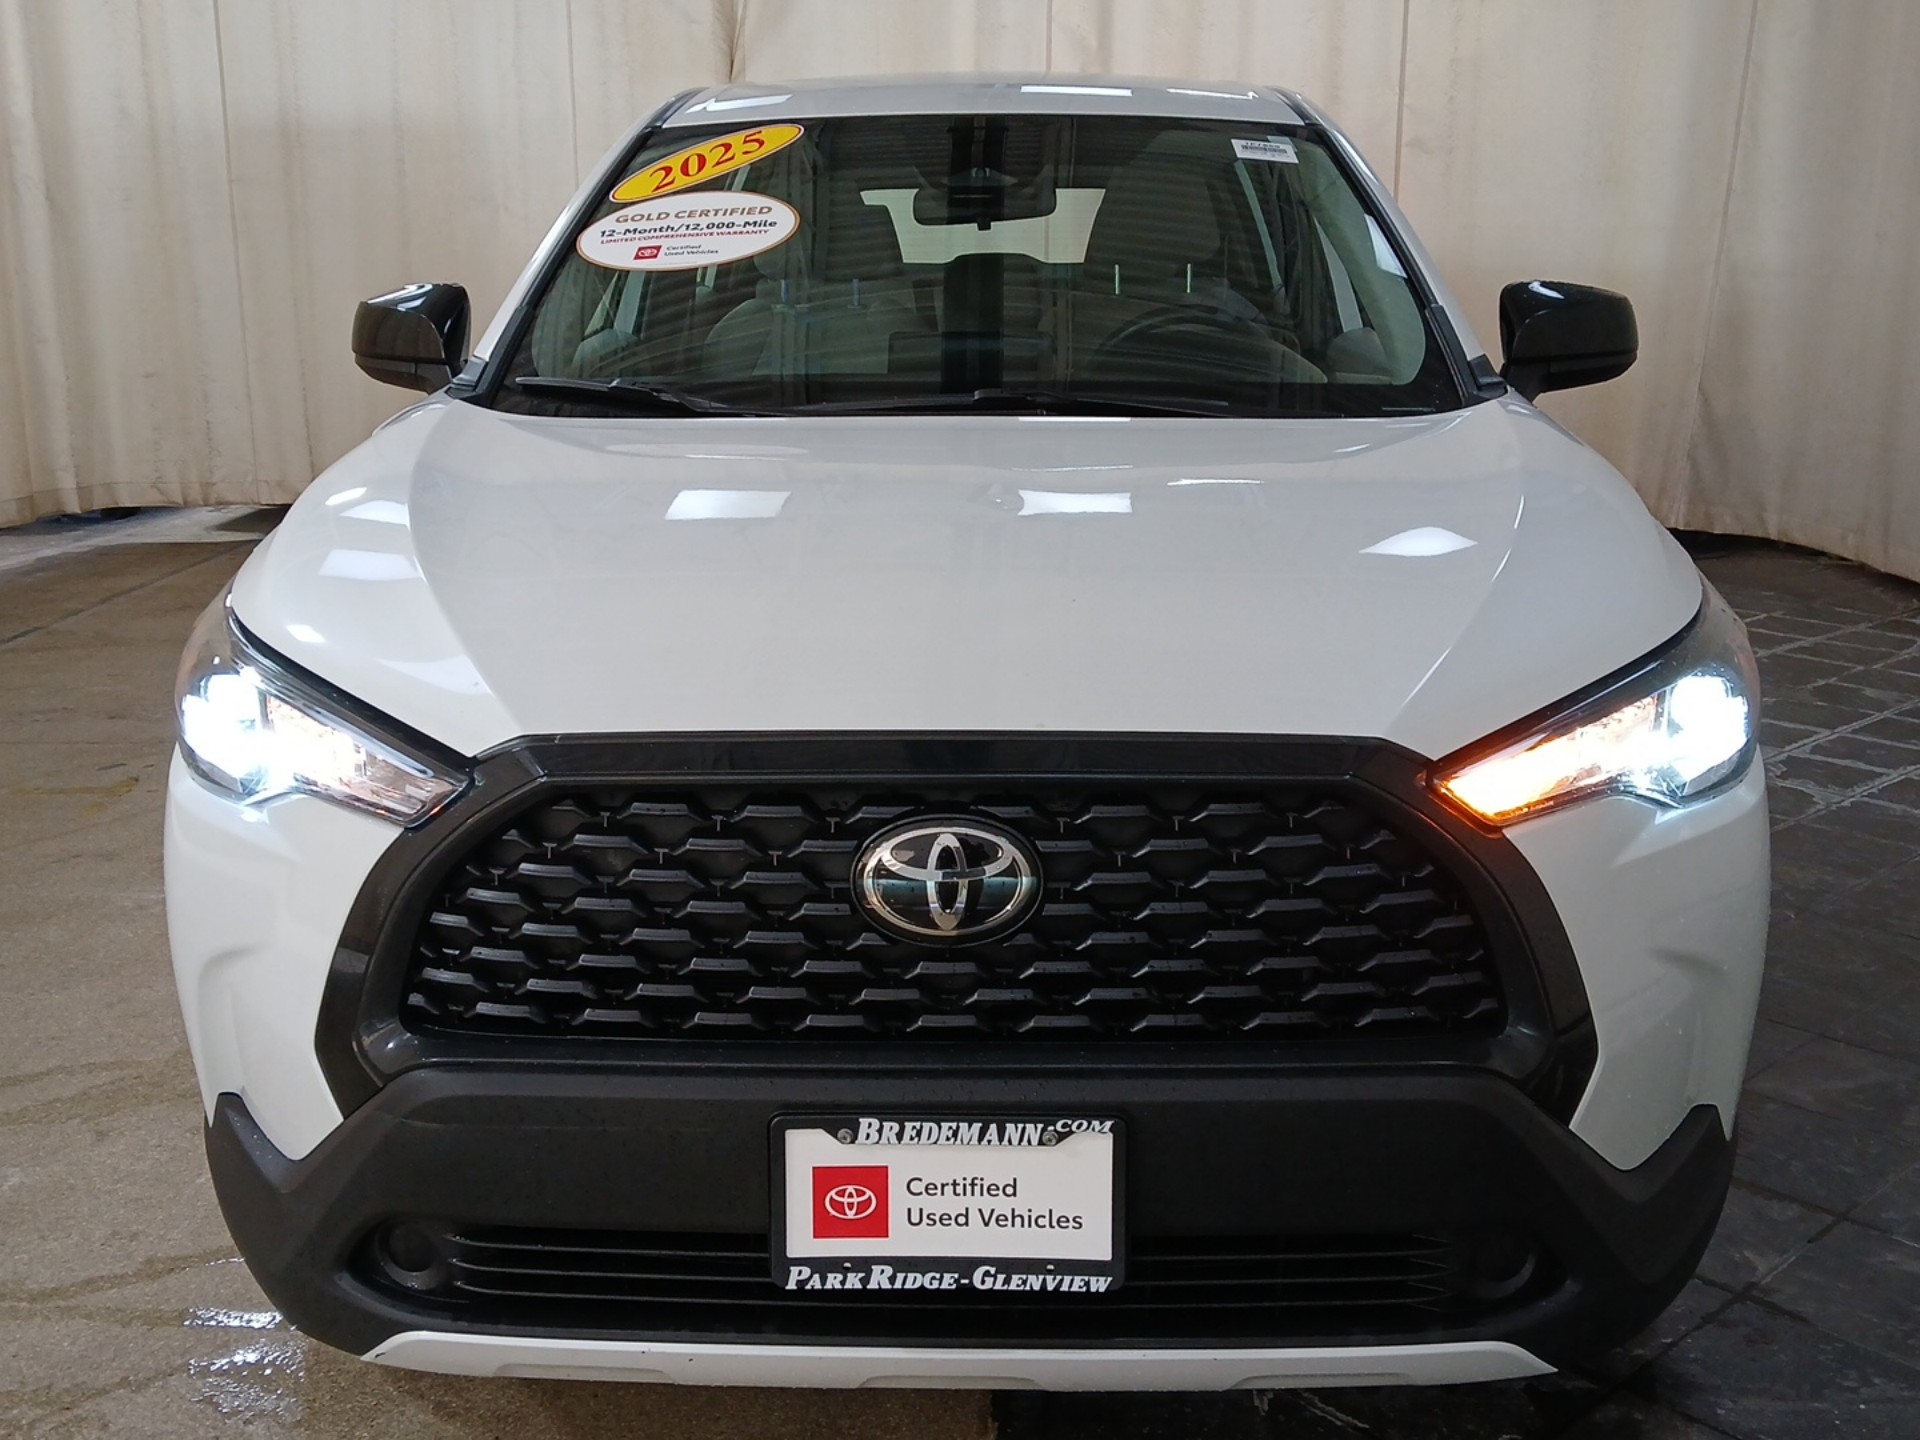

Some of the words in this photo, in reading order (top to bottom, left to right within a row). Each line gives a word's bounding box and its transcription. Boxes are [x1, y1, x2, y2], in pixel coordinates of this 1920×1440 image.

[649, 130, 766, 193] 2025
[615, 211, 670, 224] GOLD
[674, 206, 773, 220] CERTIFIED
[600, 219, 778, 238] 12-Month/12,000-Mile
[600, 236, 636, 245] LIMITED
[637, 231, 716, 242] COMPREHENSIVE
[717, 229, 769, 237] WARRANTY
[686, 248, 719, 256] Vehicles
[906, 1177, 1018, 1198] Certified
[906, 1207, 970, 1228] Used
[978, 1208, 1083, 1229] Vehicles
[786, 1265, 866, 1291] PARK
